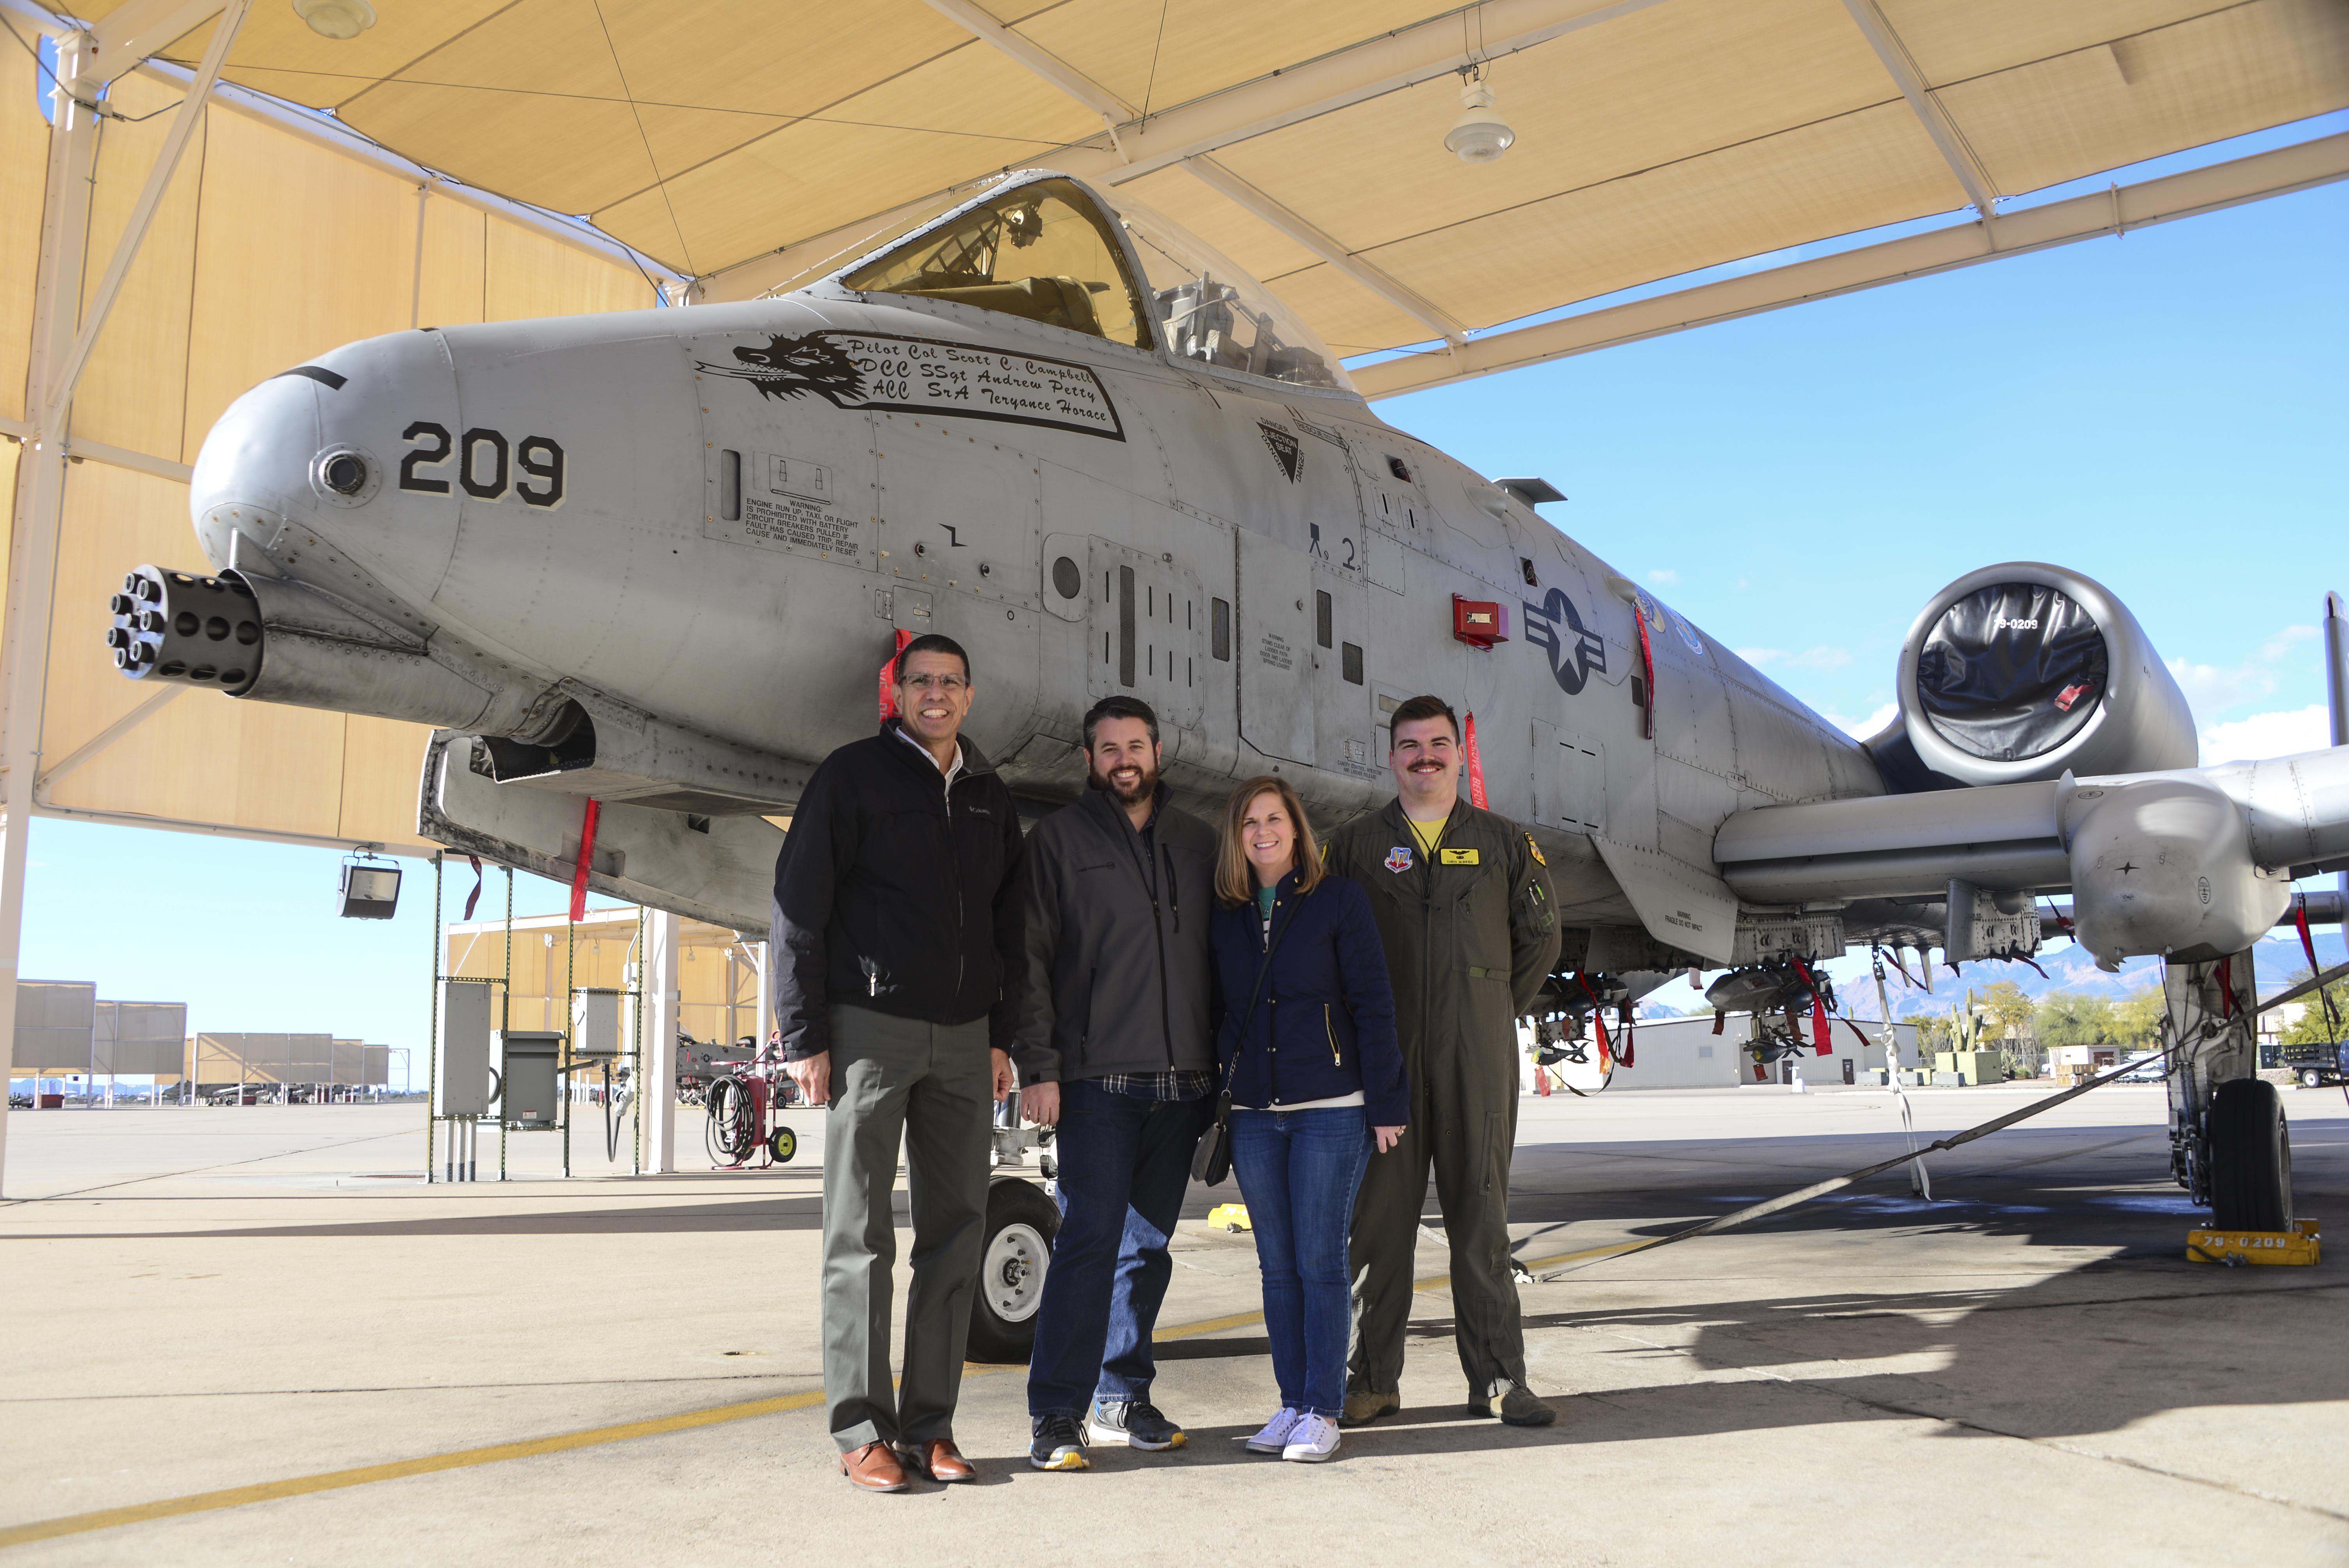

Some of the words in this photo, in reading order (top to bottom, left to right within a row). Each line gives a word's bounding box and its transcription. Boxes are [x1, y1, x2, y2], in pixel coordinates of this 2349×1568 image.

[847, 340, 900, 355] Pilot
[909, 345, 937, 360] Col
[946, 349, 991, 365] Scott
[1000, 357, 1019, 371] C.
[1025, 361, 1092, 383] Campbell
[858, 358, 911, 378] DCC
[920, 363, 967, 384] SSgt
[978, 370, 1042, 388] Andrew
[1048, 380, 1096, 403] Petty
[873, 379, 909, 399] ACC
[928, 382, 969, 399] SrA
[981, 388, 1051, 410] Teryance
[1057, 399, 1106, 421] Horace
[1260, 417, 1289, 434] DANGER
[1297, 422, 1324, 438] RESCUE
[1264, 429, 1297, 449] EJECTION
[1276, 442, 1292, 455] SEAT
[399, 421, 568, 511] 209
[1261, 435, 1286, 476] DANGER
[1296, 450, 1305, 483] DANGER
[747, 498, 772, 509] ENGINE
[776, 504, 790, 513] RUN
[806, 511, 821, 520] TAXI,
[836, 518, 858, 528] FLIGHT
[790, 500, 823, 512] WARNING:
[747, 513, 775, 524] CIRCUIT
[777, 520, 813, 533] BREAKERS
[816, 527, 841, 538] PULLED
[757, 508, 797, 522] PROHIBITED
[800, 517, 816, 526] WITH
[820, 522, 848, 533] BATTERY
[746, 520, 767, 530] FAULT
[770, 525, 784, 533] HAS
[787, 529, 815, 540] CAUSED
[818, 535, 833, 545] TRIP,
[836, 540, 858, 550] REPAIR
[746, 528, 770, 538] CAUSE
[773, 533, 787, 542] AND
[790, 537, 833, 552] IMMEDIATELY
[836, 547, 857, 556] RESET
[1268, 633, 1284, 642] WARNING
[1265, 646, 1278, 655] LADDER
[1279, 657, 1292, 665] LADDER
[1263, 658, 1275, 666] SPRING
[1277, 662, 1290, 670] LOADED
[1472, 777, 1485, 809] BEFOR
[1665, 915, 1678, 925] FRAGILE
[1692, 923, 1702, 932] IMPACT
[1677, 910, 1691, 920] WARNING
